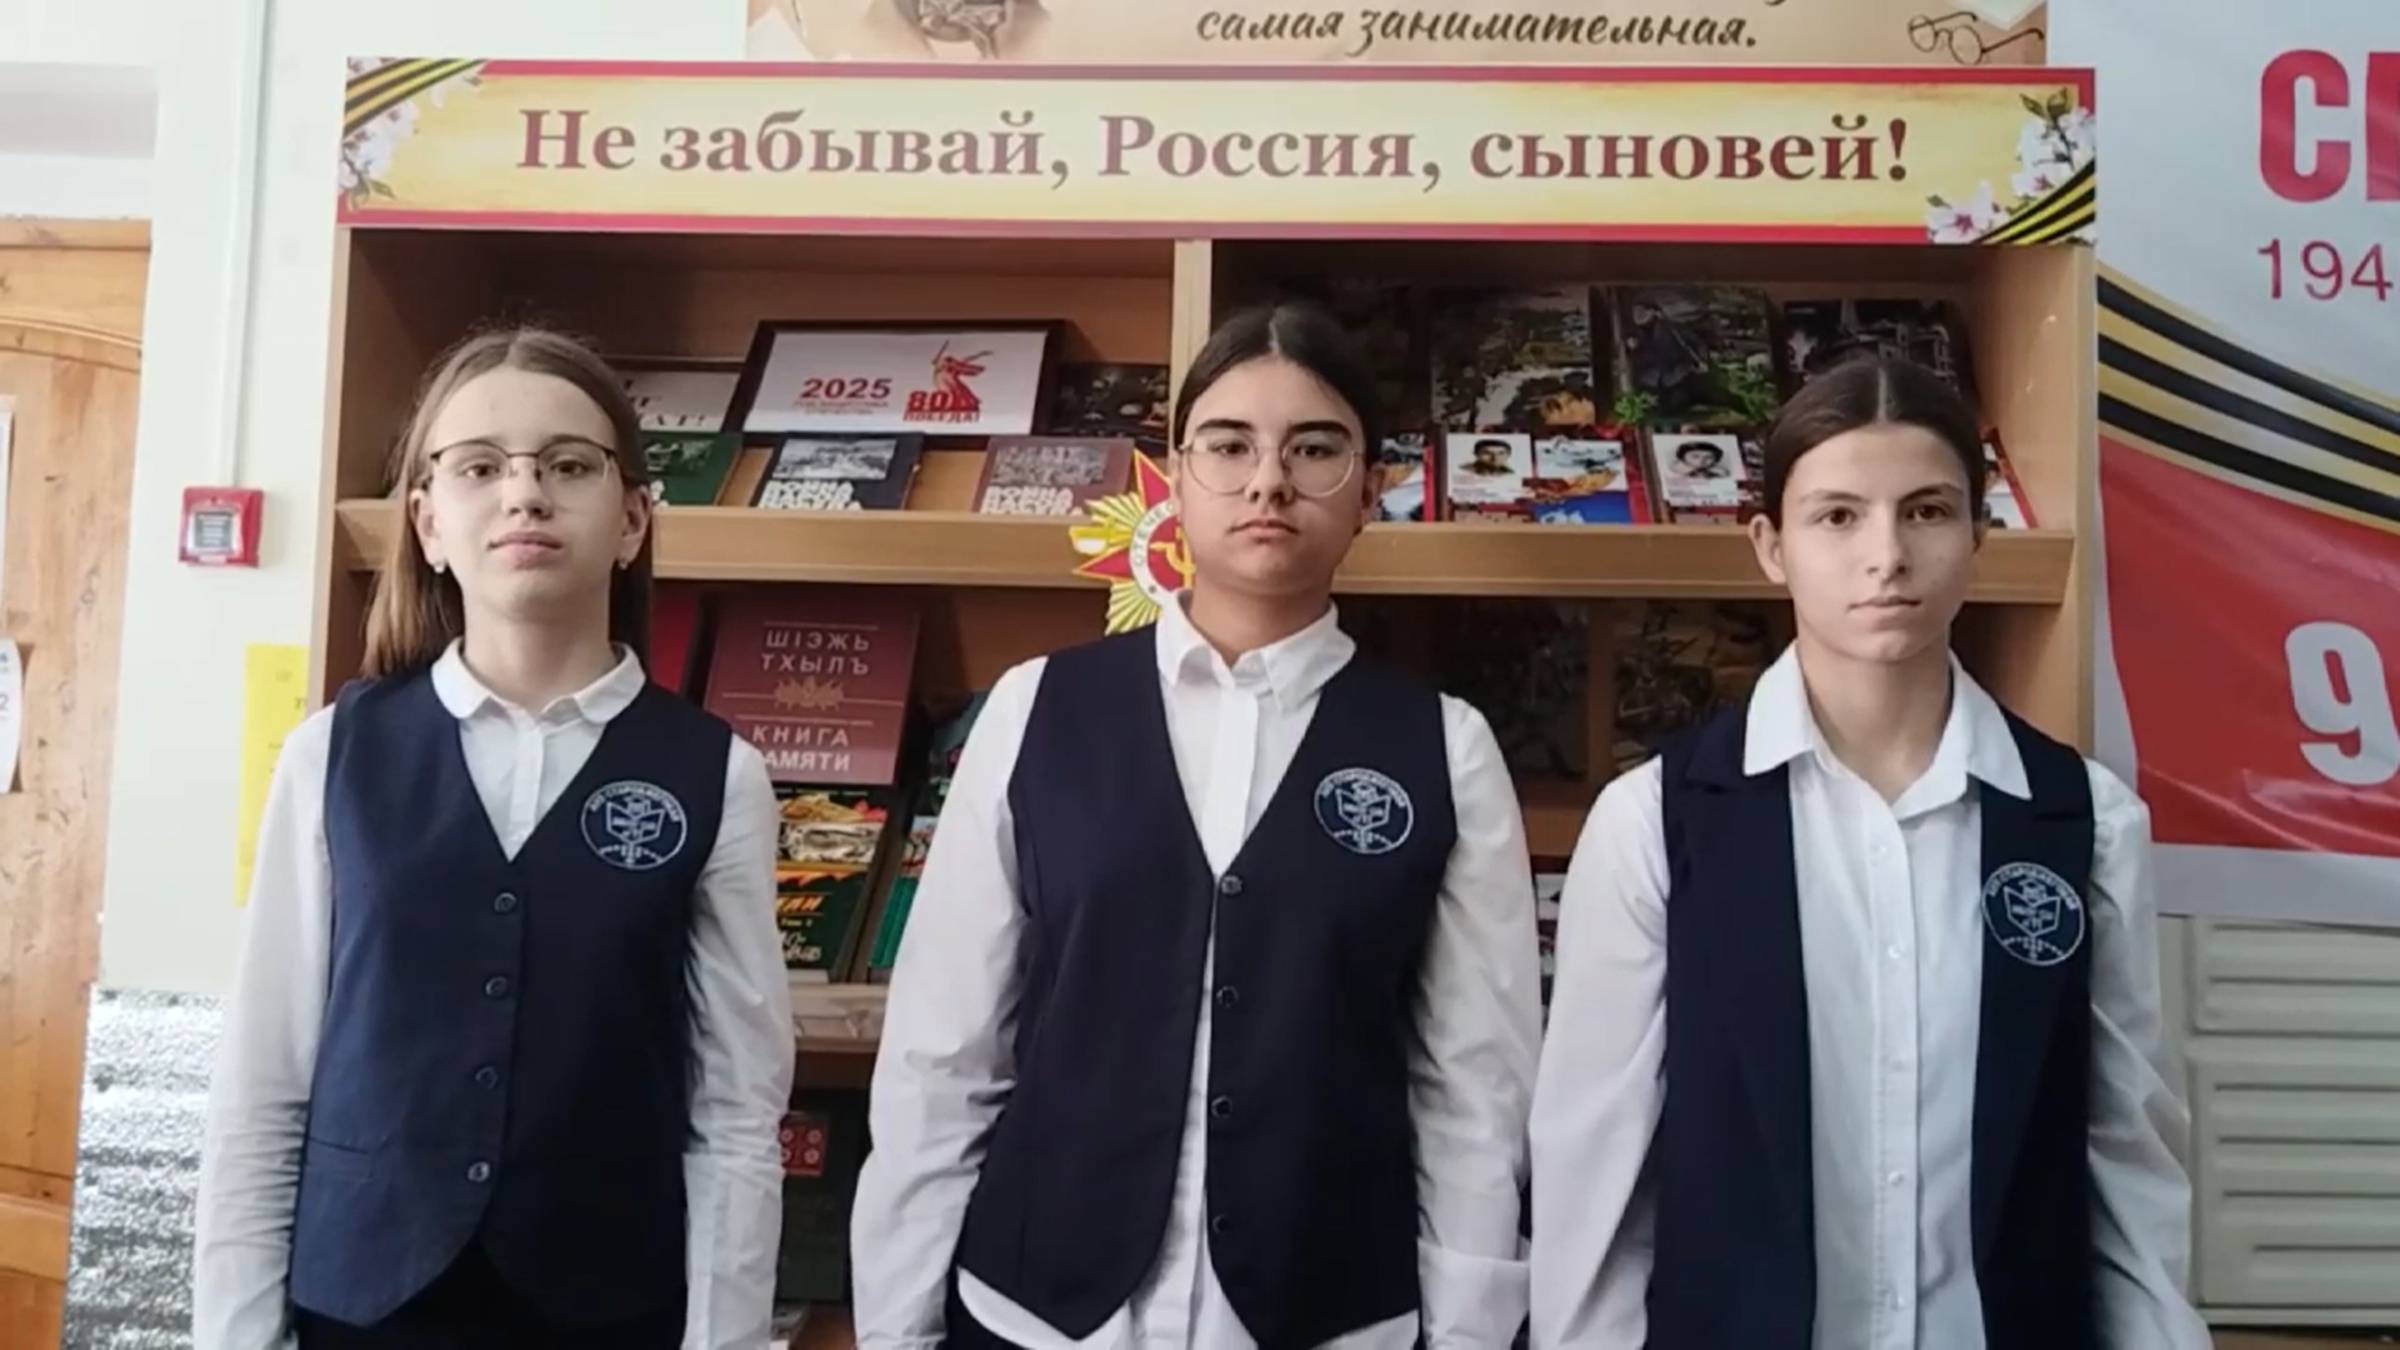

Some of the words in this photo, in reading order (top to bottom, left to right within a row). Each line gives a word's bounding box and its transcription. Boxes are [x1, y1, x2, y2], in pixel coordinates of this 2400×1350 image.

[1197, 12, 1344, 40] самая
[1347, 10, 1757, 57] занимательная.
[520, 109, 635, 170] Не
[660, 107, 1068, 190] забывай,
[1101, 116, 1441, 192] Россия,
[1470, 112, 1909, 182] сыновей!
[798, 377, 893, 399] 2025
[761, 653, 869, 675] ТХЫЛЪ
[752, 724, 849, 747] КНИГА
[763, 748, 851, 772] АМЯТИ
